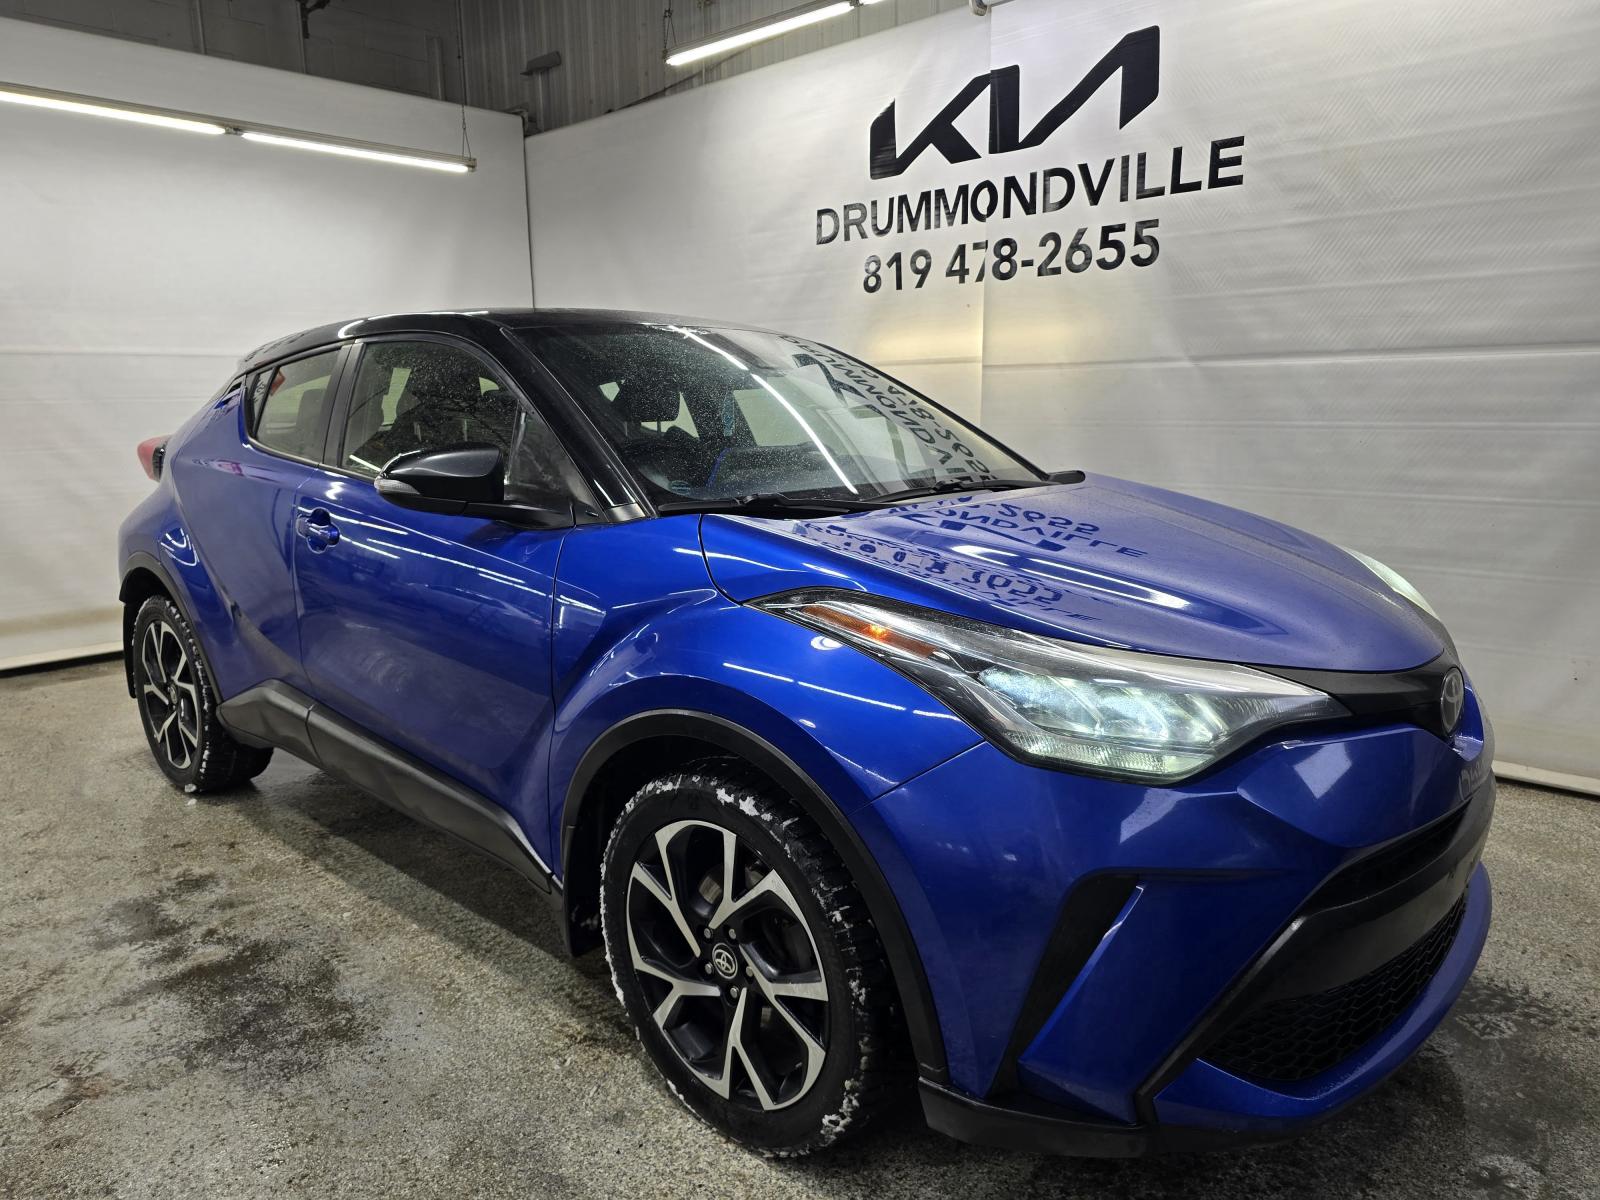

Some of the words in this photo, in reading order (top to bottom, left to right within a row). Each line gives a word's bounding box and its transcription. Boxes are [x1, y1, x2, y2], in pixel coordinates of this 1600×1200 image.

[869, 25, 1160, 180] KIA
[816, 135, 1245, 246] DRUMMONDVILLE
[863, 248, 933, 294] 819
[945, 218, 1160, 285] 478-2655
